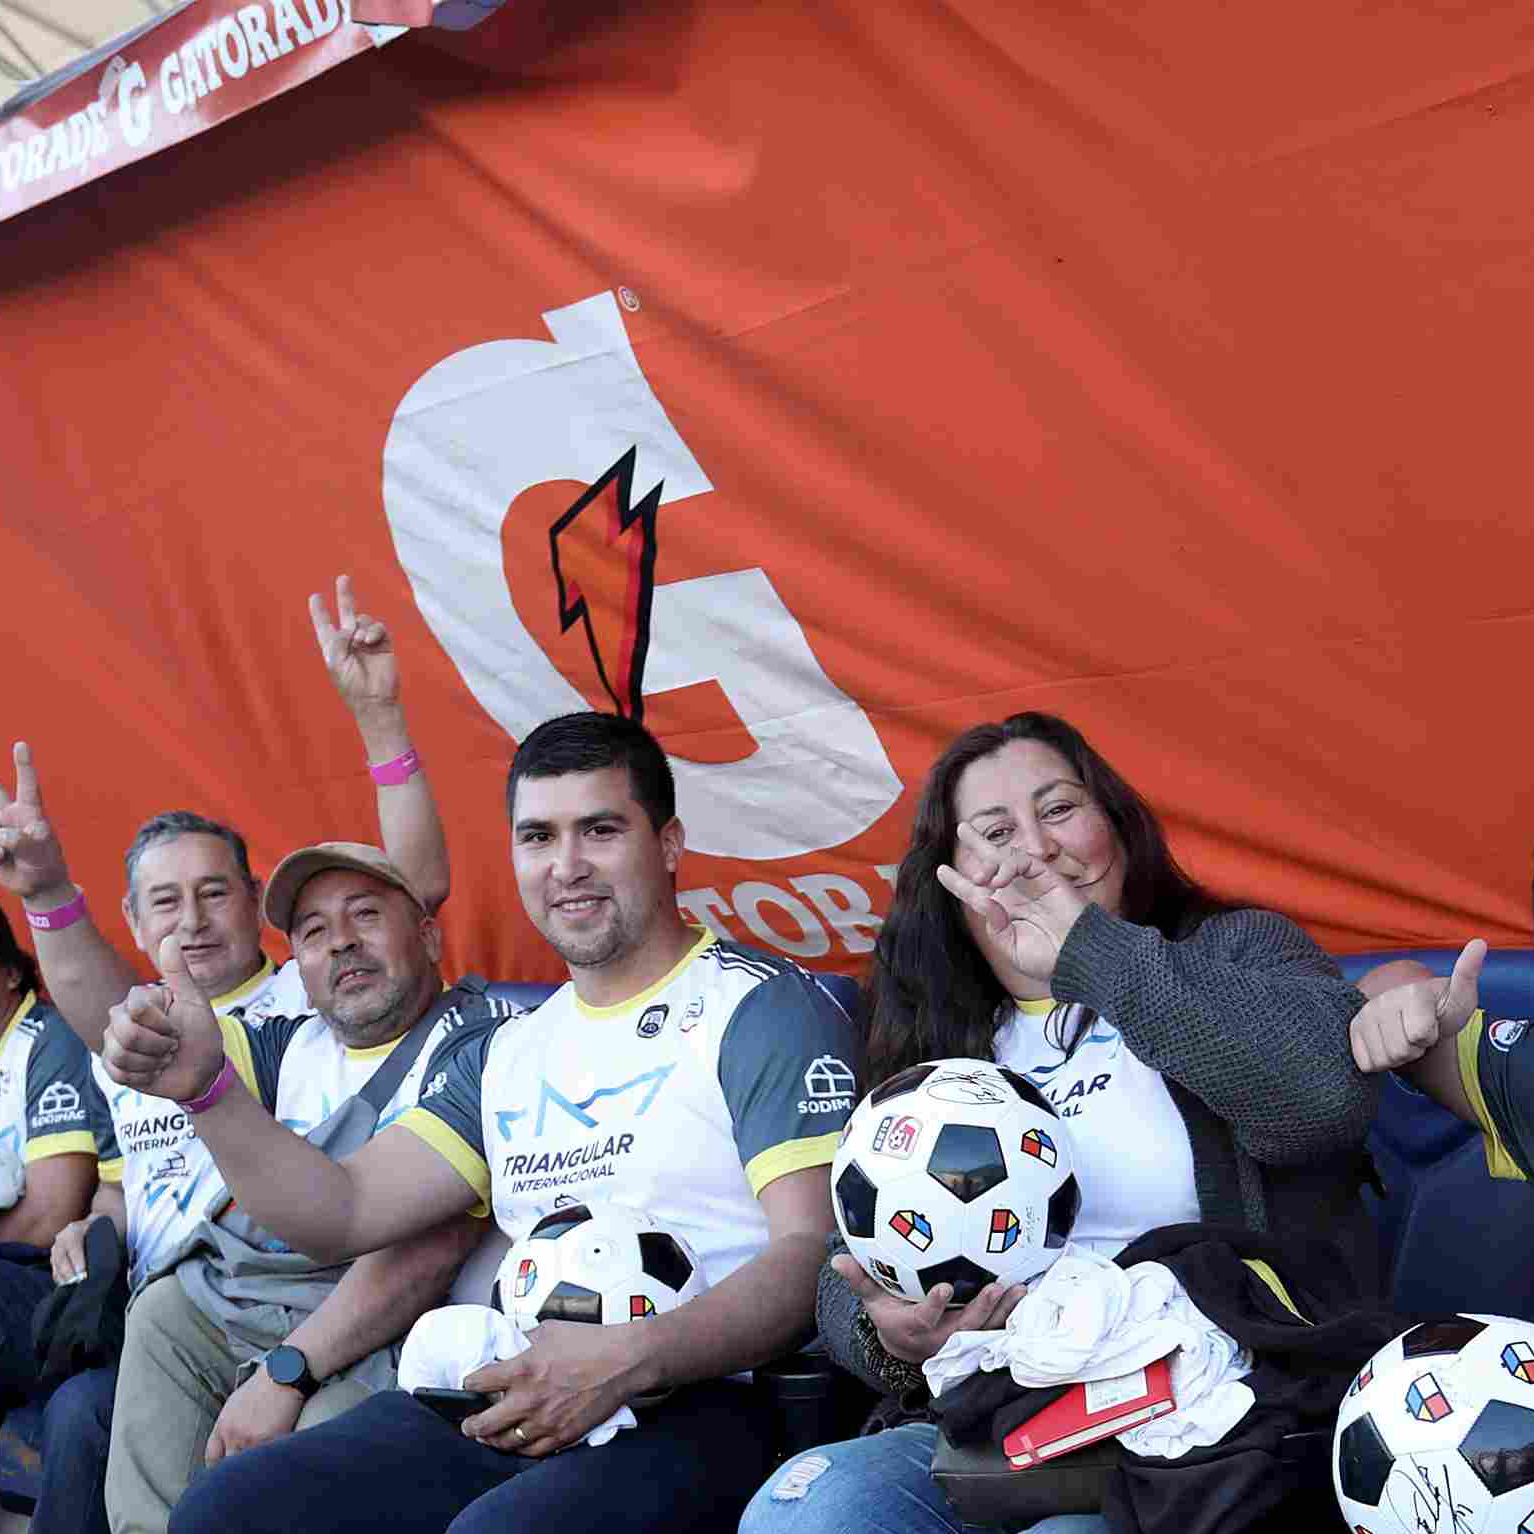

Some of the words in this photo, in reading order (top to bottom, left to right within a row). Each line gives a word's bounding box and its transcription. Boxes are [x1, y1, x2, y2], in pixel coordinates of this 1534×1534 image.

[116, 60, 152, 147] G
[159, 0, 354, 115] GATORAD
[797, 1097, 852, 1115] SODIM
[502, 1132, 635, 1178] TRIANGULAR
[512, 1161, 616, 1194] INTERNACIONAL
